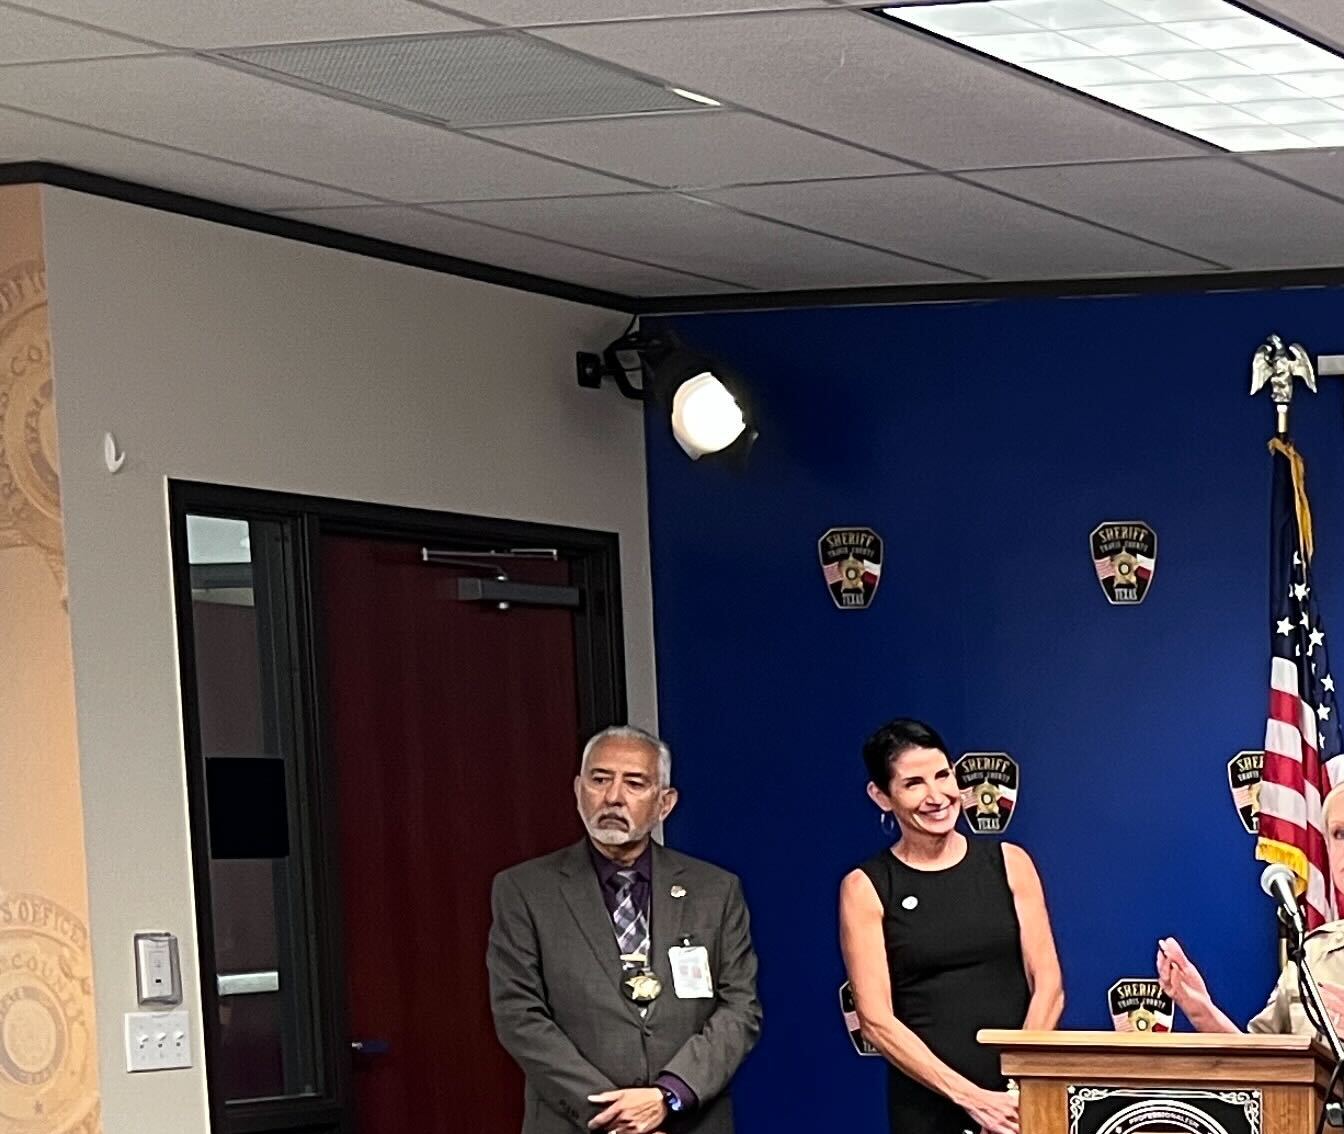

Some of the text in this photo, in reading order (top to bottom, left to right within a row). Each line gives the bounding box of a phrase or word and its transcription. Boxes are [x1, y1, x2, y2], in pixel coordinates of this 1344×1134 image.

[827, 532, 875, 547] SHERIFF
[1098, 526, 1148, 542] SHERIFF
[842, 593, 864, 606] TEXAS
[1115, 588, 1137, 601] TEXAS
[961, 758, 1011, 773] SHERIFF
[978, 817, 1000, 829] TEXAS
